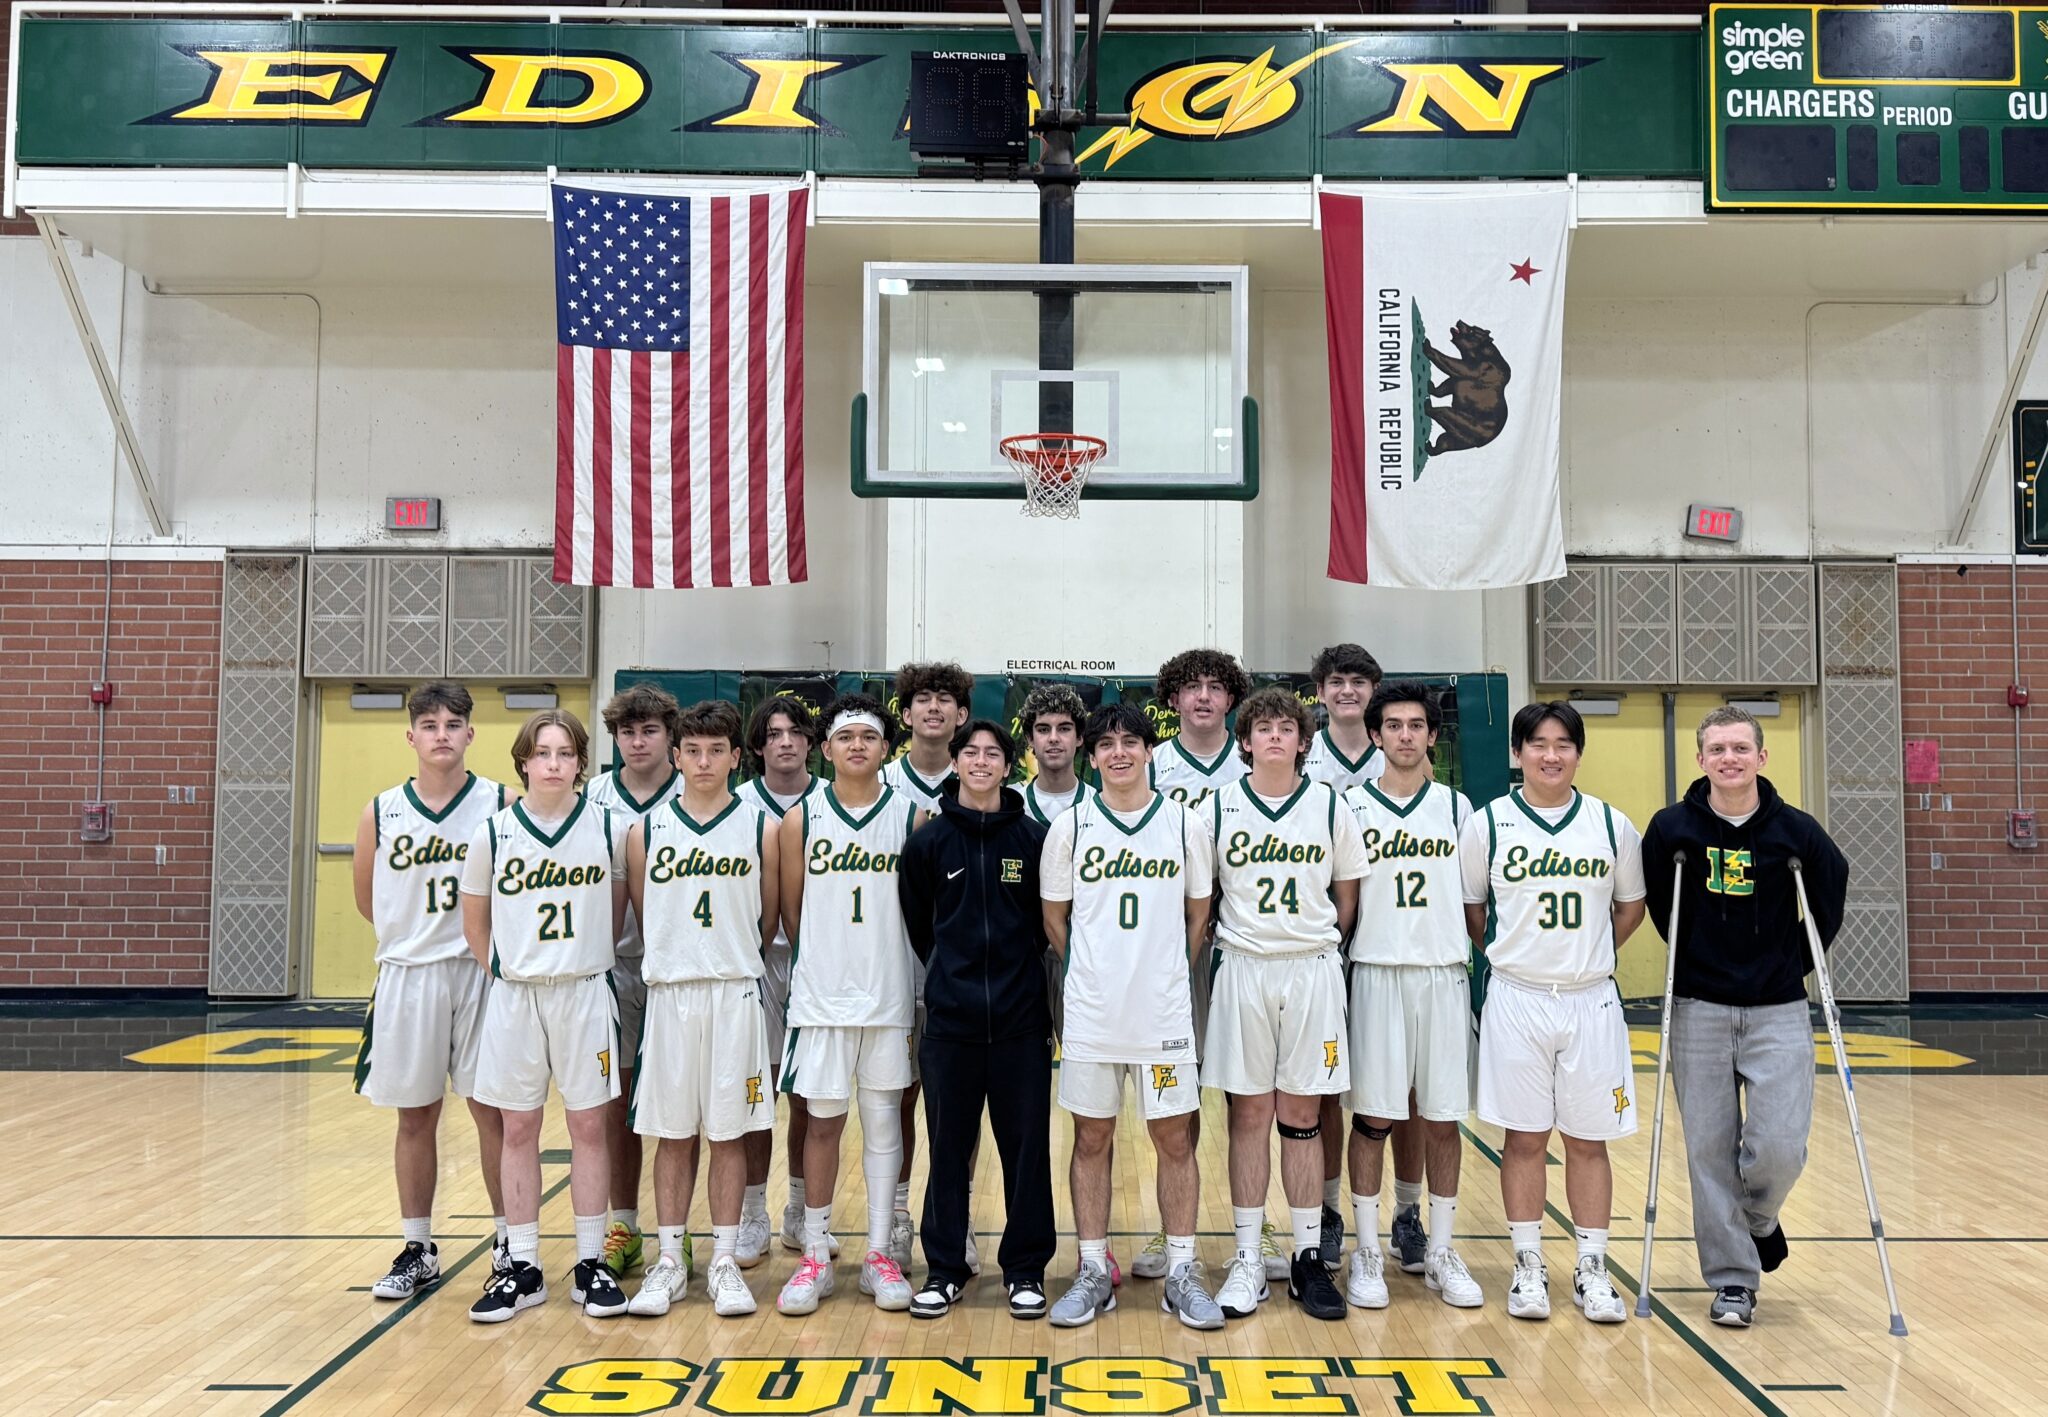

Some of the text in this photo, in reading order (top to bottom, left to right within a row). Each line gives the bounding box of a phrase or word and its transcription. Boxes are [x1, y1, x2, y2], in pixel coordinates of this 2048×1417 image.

[1722, 21, 1805, 49] simple
[933, 51, 1006, 61] DAKTRONICS
[1725, 50, 1803, 75] green
[127, 40, 1605, 170] EDION
[1726, 89, 1875, 118] CHARGERS
[1883, 107, 1952, 126] PERIOD
[1379, 288, 1402, 490] CALIFORNIA REPUBLIC
[395, 500, 428, 527] EXIT
[1697, 508, 1733, 538] EXIT
[1006, 660, 1116, 671] ELECTRICAL ROOM
[389, 834, 469, 871] Ediso
[650, 846, 752, 884] Edison
[808, 838, 901, 875] Edison
[1079, 846, 1181, 883] Edison
[1226, 831, 1326, 867] Edison
[1362, 828, 1456, 865] Edison
[1502, 845, 1610, 882] Edison
[425, 875, 459, 914] 13
[497, 857, 606, 896] Edison
[1394, 871, 1429, 908] 12
[693, 890, 714, 928] 4
[851, 885, 864, 924] 1
[1118, 892, 1139, 930] 0
[1256, 877, 1300, 914] 24
[1537, 891, 1583, 930] 30
[537, 900, 576, 942] 21
[525, 1357, 1507, 1417] SUNSET
